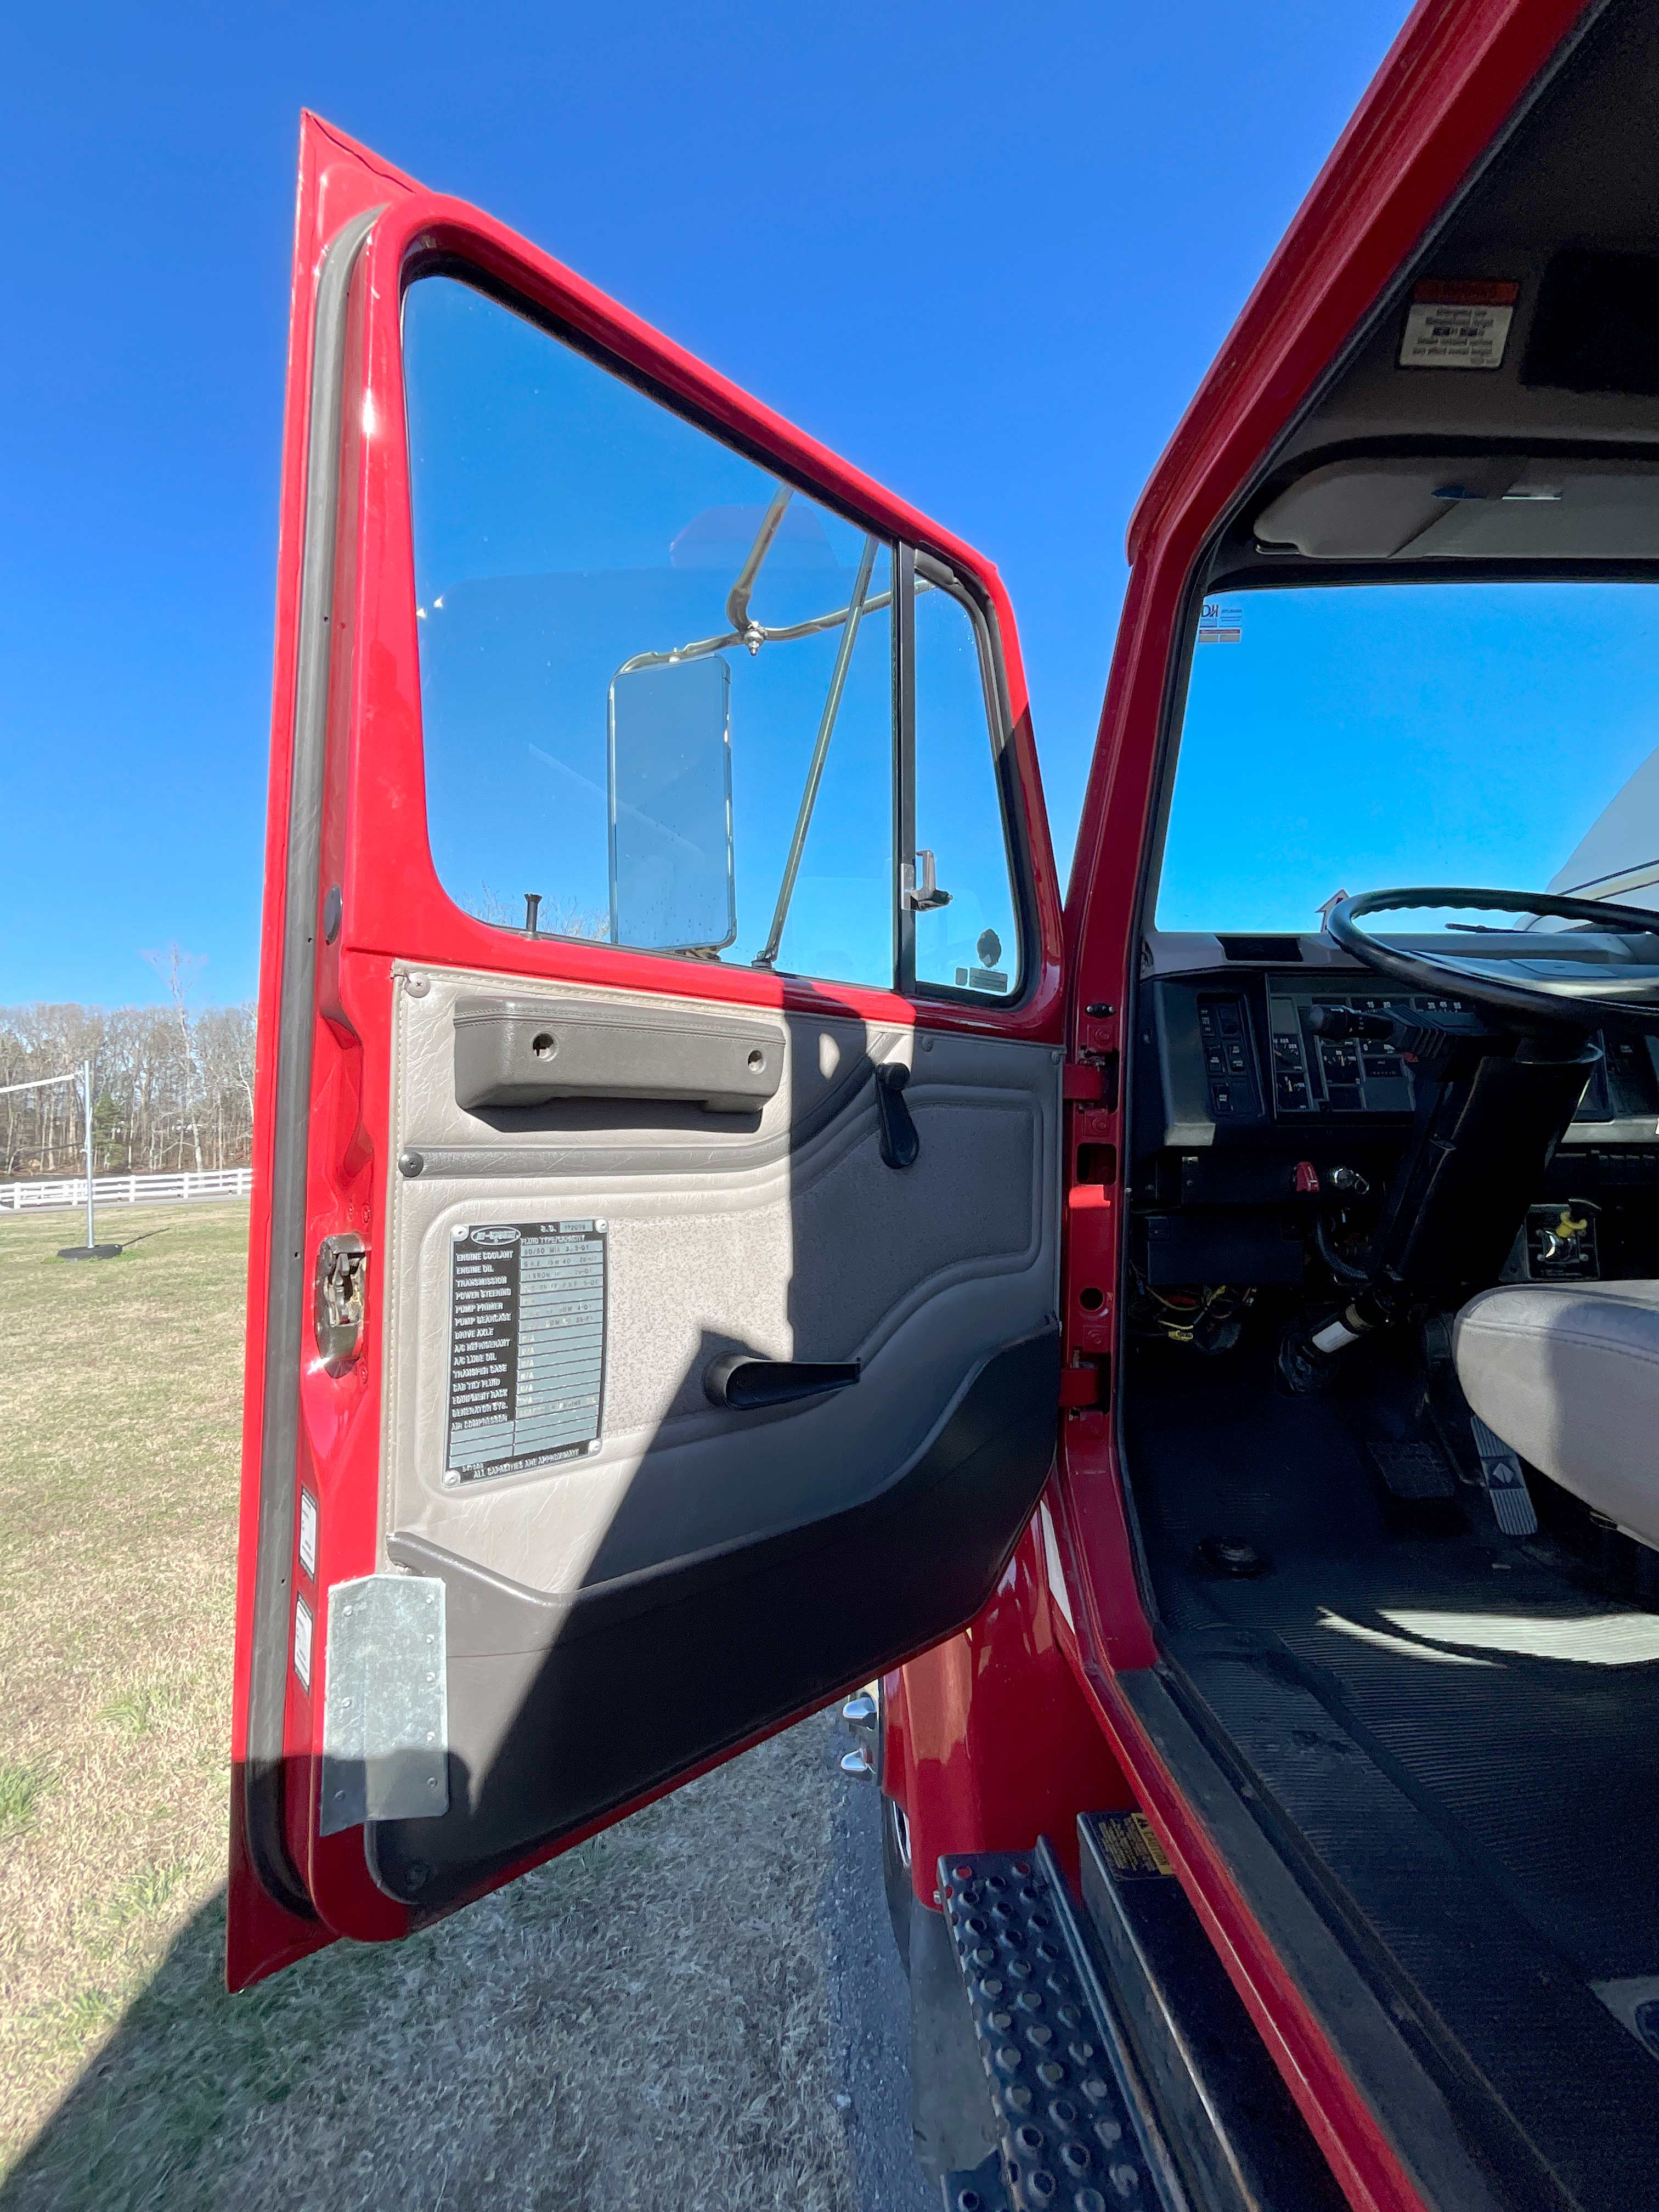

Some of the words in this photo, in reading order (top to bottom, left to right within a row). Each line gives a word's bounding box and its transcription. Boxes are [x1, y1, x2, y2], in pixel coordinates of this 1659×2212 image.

[456, 1252, 482, 1261] ENGINE
[483, 1251, 514, 1260] COOLANT
[456, 1266, 482, 1274] ENGINE
[482, 1265, 494, 1273] OIL
[455, 1276, 507, 1288] TRANSMISSION
[455, 1291, 479, 1300] POWER
[480, 1288, 511, 1298] STEERING
[455, 1305, 476, 1314] PUMP
[476, 1303, 503, 1312] PRIMER
[455, 1318, 476, 1327] PUMP
[477, 1313, 512, 1324] GEARCASE
[455, 1330, 476, 1340] DRIVE
[477, 1327, 494, 1337] AXLE
[454, 1344, 465, 1353] A/C
[466, 1339, 510, 1351] REFRIGERANT
[454, 1356, 465, 1365] A/C
[466, 1354, 484, 1364] LUBE
[486, 1352, 497, 1361] OIL
[453, 1367, 488, 1379] TRANSFER
[490, 1364, 507, 1373] CASE
[453, 1384, 466, 1392] CAB
[466, 1381, 480, 1390] TILT
[481, 1378, 501, 1387] FLUID
[452, 1392, 490, 1404] EQUIPMENT
[490, 1389, 508, 1399] RACK
[452, 1404, 492, 1418] GENERATOR
[492, 1402, 509, 1411] SYS.
[452, 1422, 462, 1431] AIR
[464, 1414, 508, 1429] COMPRESSOR
[473, 1469, 486, 1479] ALL
[487, 1461, 523, 1476] CAPACITIES
[524, 1458, 538, 1468] ARE
[538, 1449, 580, 1465] APPROXIMATE
